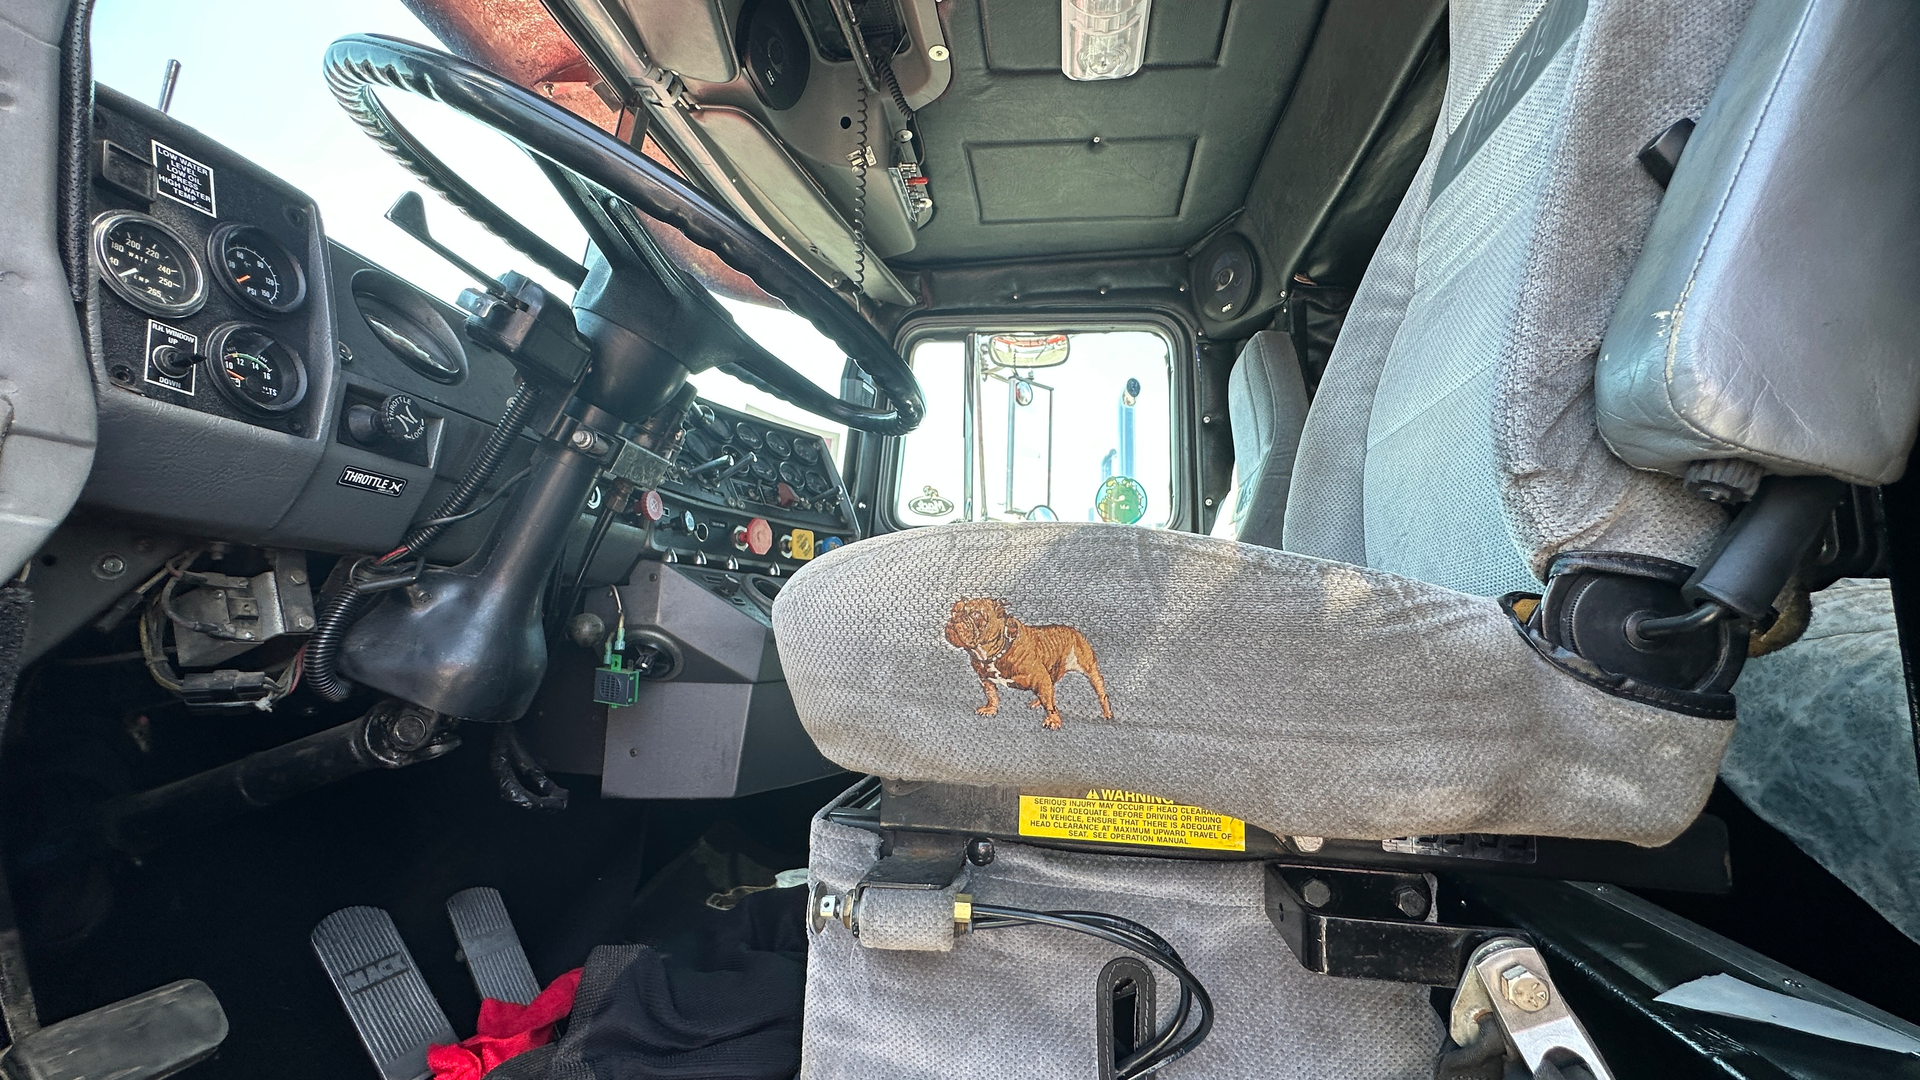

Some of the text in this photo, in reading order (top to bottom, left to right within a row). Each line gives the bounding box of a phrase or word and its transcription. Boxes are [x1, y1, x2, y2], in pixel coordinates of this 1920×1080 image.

[158, 147, 208, 176] LOW WATER
[166, 164, 202, 186] LOW OIL
[170, 160, 198, 178] LEVEL
[158, 174, 211, 202] HIGH WATER
[171, 174, 198, 190] PRESS
[111, 242, 124, 252] 180
[126, 238, 140, 250] 200
[146, 248, 160, 259] 220
[157, 264, 171, 275] 240
[158, 276, 173, 288] 250
[147, 286, 162, 298] 265
[247, 286, 270, 298] PSI 150
[166, 328, 194, 343] WINDOW
[225, 361, 234, 370] 10
[236, 358, 244, 366] 12
[252, 362, 260, 370] 14
[159, 376, 181, 388] DOWN
[263, 372, 271, 380] 16
[389, 396, 412, 420] THROTTLE
[411, 424, 424, 440] LOCK
[344, 470, 390, 489] THROTTLE
[1034, 798, 1067, 806] SERIOUS
[1068, 808, 1110, 816] ADEQUATE.
[1113, 810, 1143, 818] BEFORE
[1050, 814, 1084, 823] VEHICLE,
[1180, 823, 1222, 832] ADEQUATE
[1053, 822, 1100, 831] CLEARANCE
[1114, 826, 1150, 834] MAXIMUM
[1189, 830, 1218, 839] TRAVEL
[1110, 833, 1154, 842] OPERATION
[1156, 836, 1192, 845] MANUAL.
